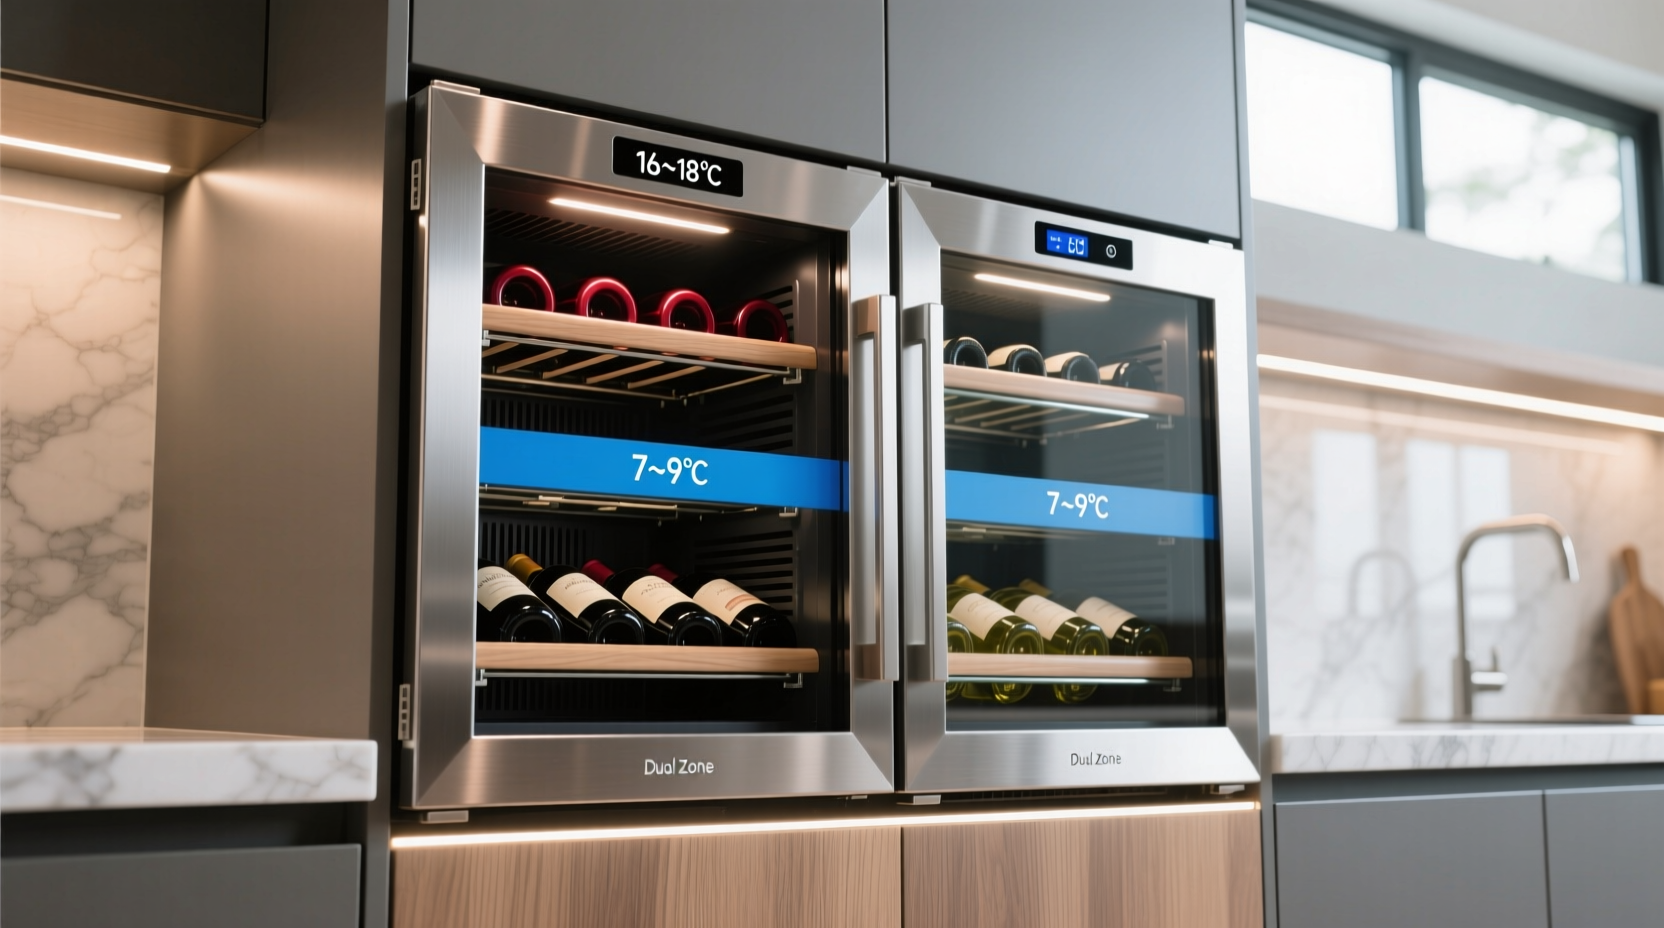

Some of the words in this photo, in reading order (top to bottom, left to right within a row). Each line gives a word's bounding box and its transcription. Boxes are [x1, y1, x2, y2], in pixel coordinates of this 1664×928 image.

[644, 756, 676, 775] Dual
[678, 759, 714, 774] Zone
[1094, 753, 1122, 766] Zone
